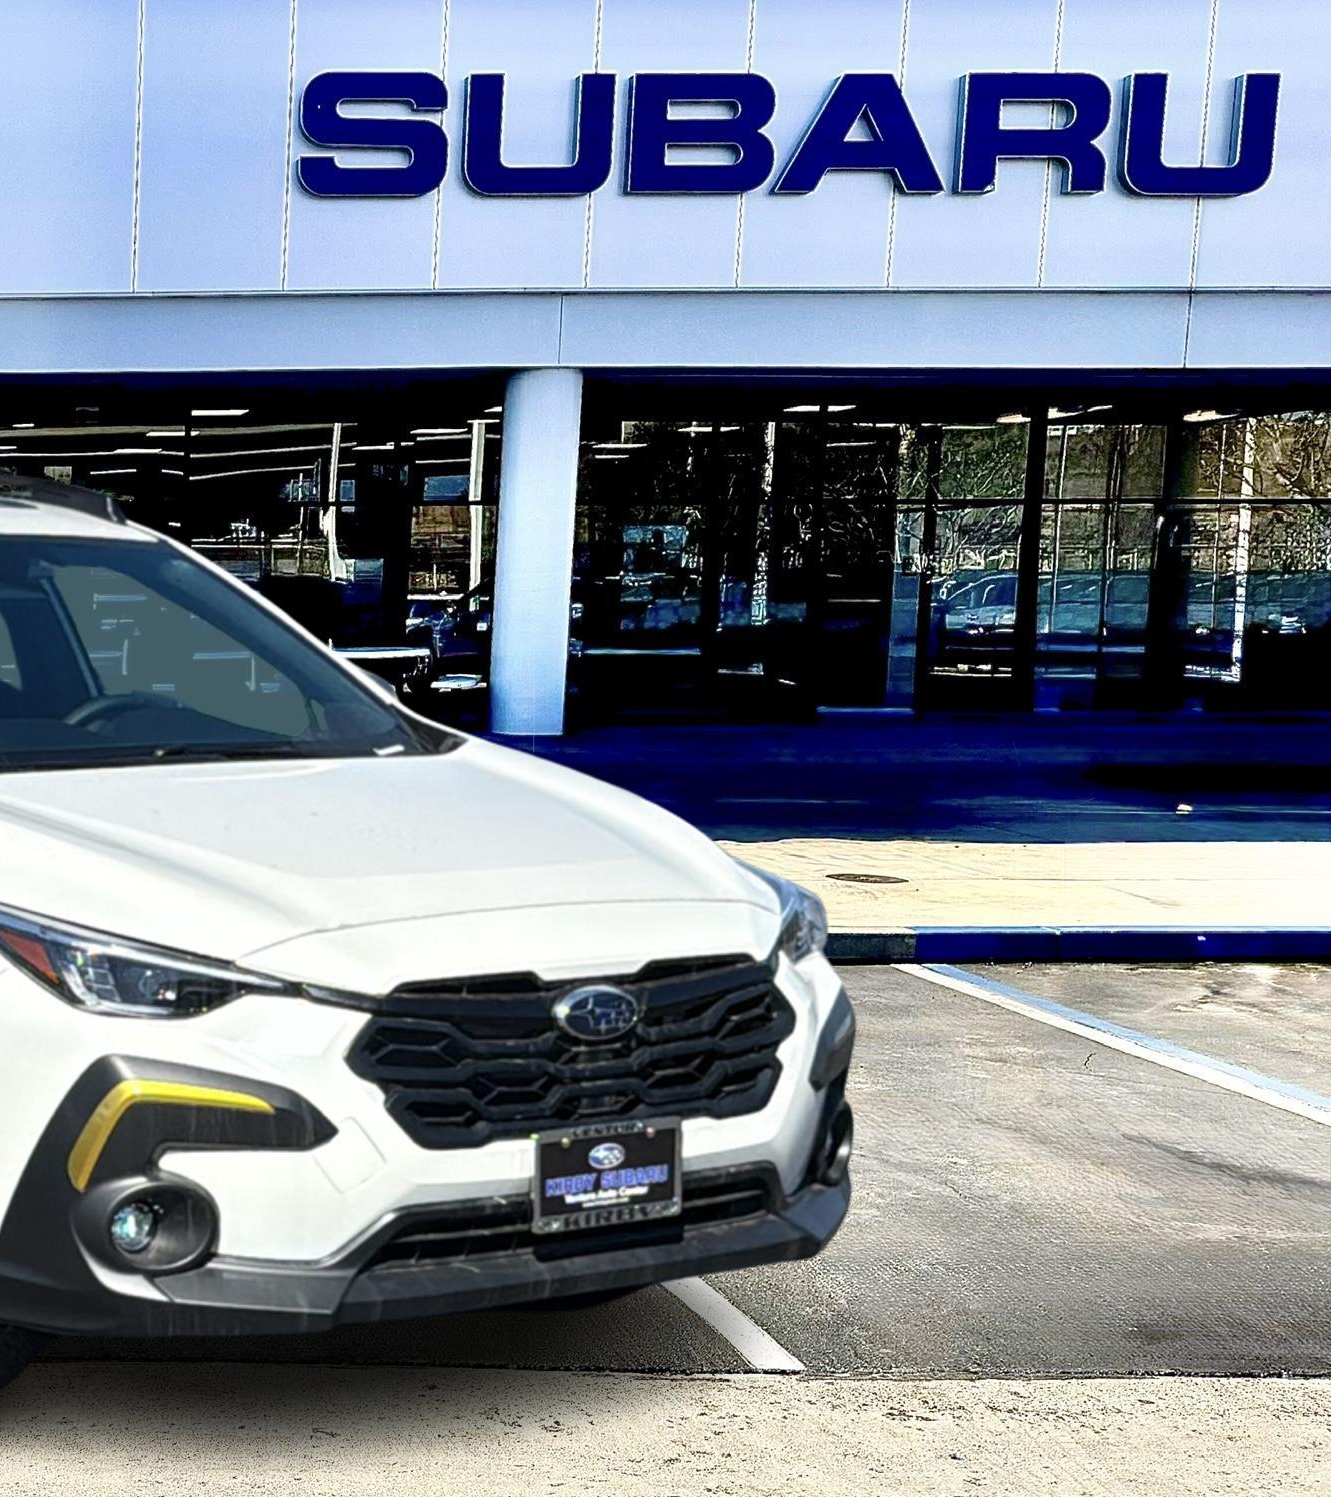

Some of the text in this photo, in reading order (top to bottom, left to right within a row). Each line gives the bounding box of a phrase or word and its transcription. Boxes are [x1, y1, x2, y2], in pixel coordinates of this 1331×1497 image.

[297, 72, 1279, 198] SUBARU
[545, 1164, 669, 1197] KIRBY SUBARU
[563, 1206, 651, 1228] KIRBY
